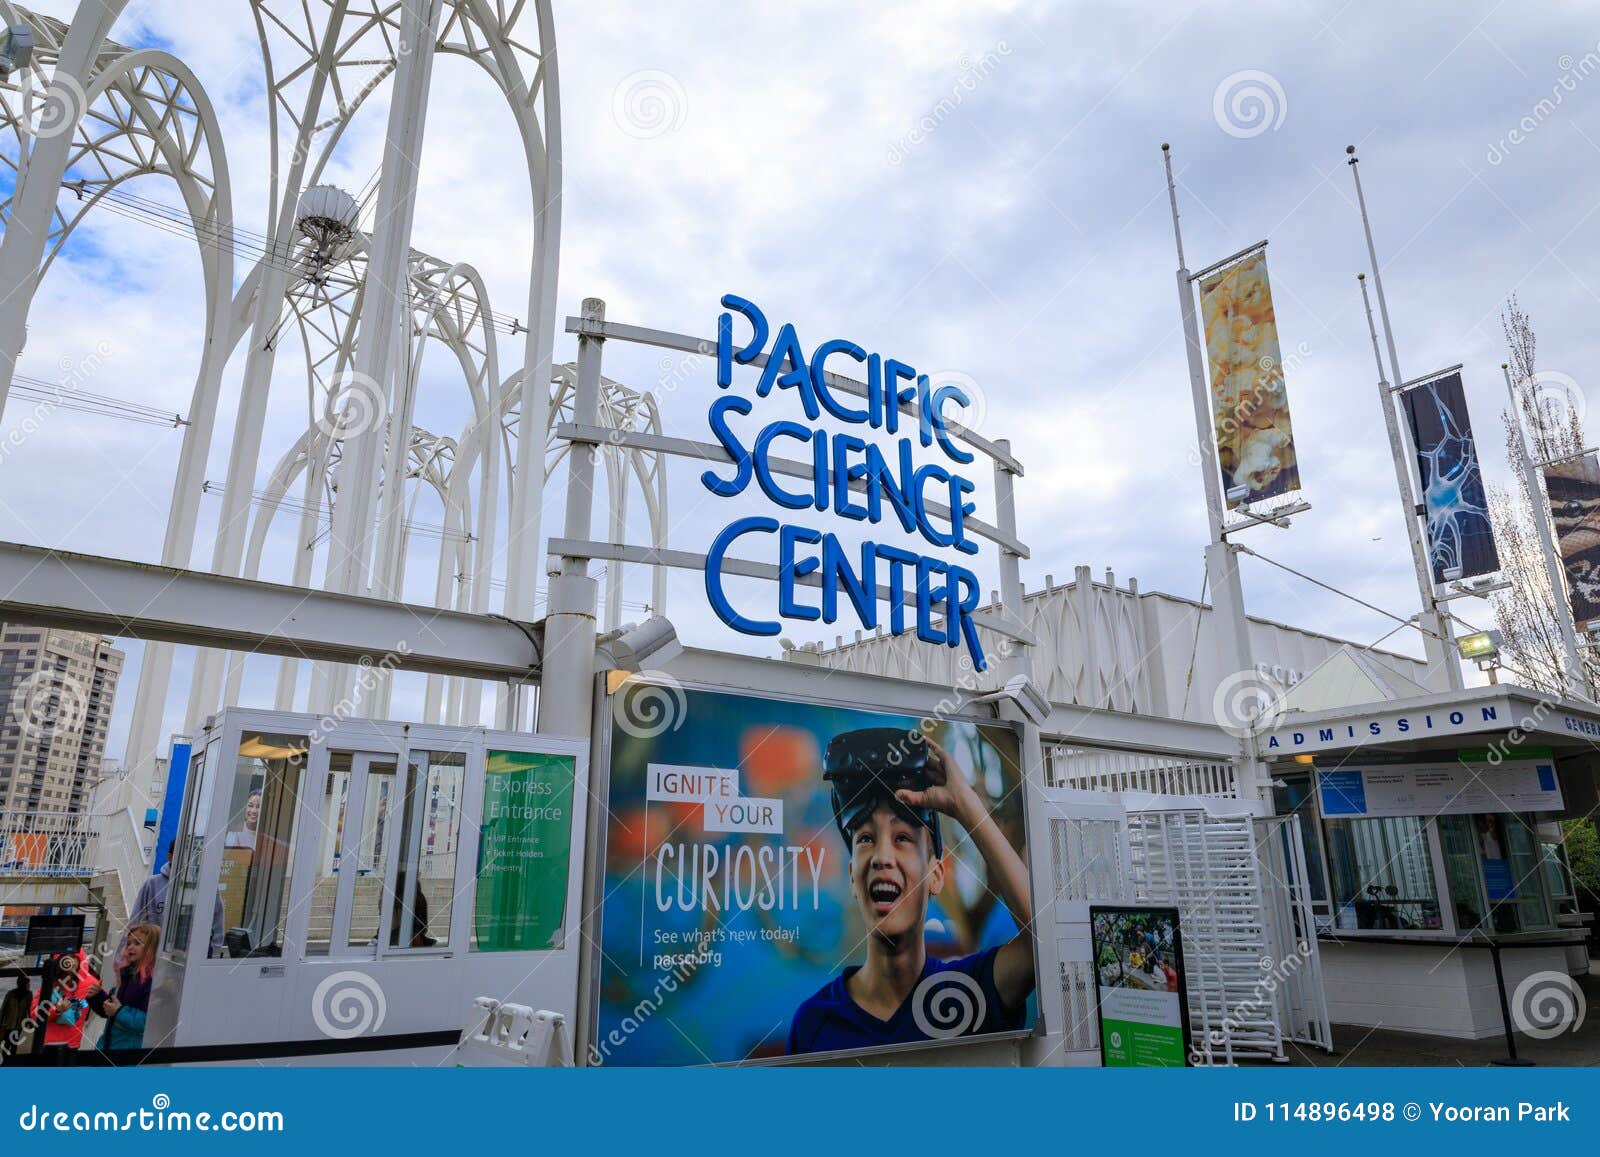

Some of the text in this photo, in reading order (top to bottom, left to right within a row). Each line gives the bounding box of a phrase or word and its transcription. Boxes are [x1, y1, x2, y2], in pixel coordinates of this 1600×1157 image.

[717, 293, 975, 464] PACIFIC
[701, 395, 979, 555] SCIENCE
[704, 516, 988, 673] CENTER
[1268, 706, 1497, 749] ADMISSION
[491, 775, 552, 797] Express
[656, 772, 730, 797] IGNITE
[490, 801, 562, 821] Entrance
[715, 803, 774, 826] YOUR
[655, 842, 826, 912] CURIOSITY
[654, 926, 800, 944] See what's new today!
[653, 950, 722, 970] pacsci.org
